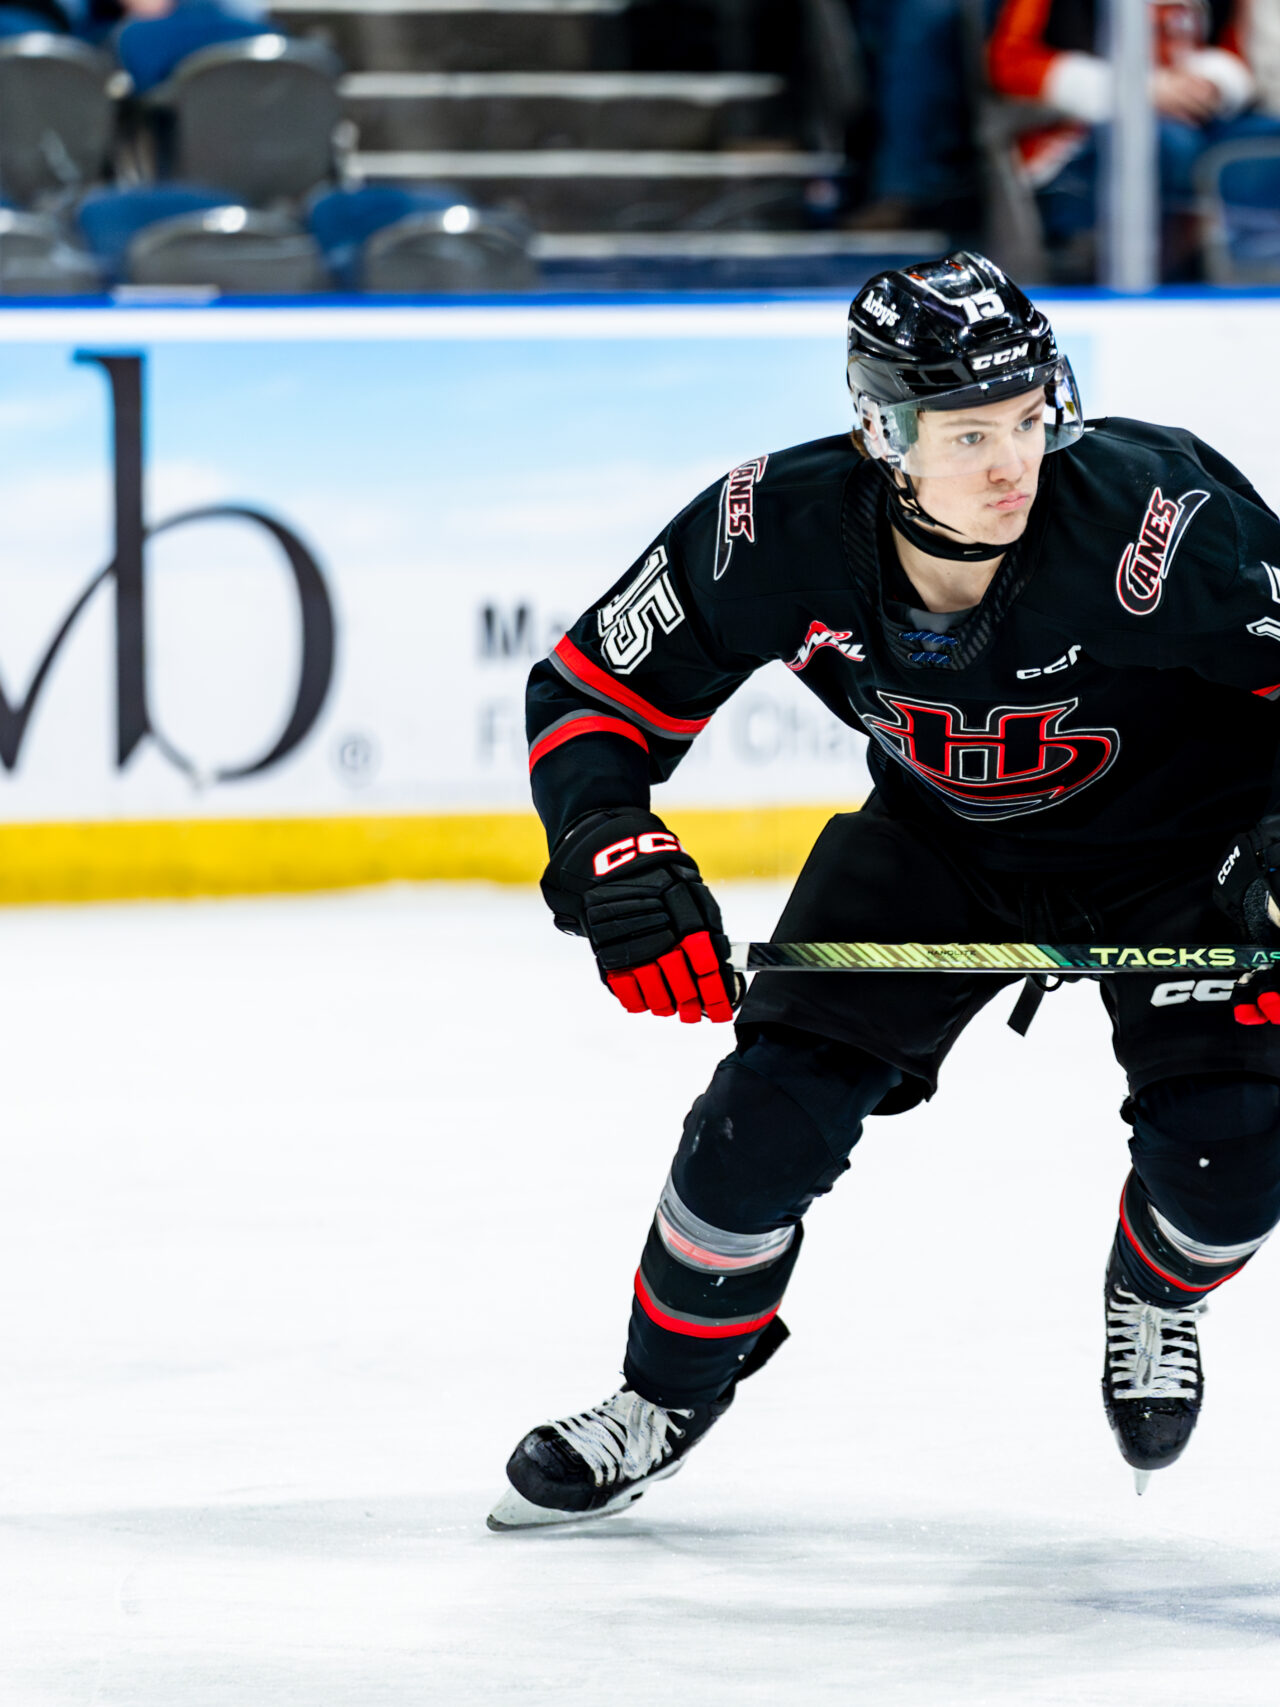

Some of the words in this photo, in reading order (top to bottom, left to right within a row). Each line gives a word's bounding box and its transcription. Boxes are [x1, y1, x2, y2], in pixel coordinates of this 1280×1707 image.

[971, 342, 1029, 371] CCM
[1116, 487, 1180, 615] CANES
[597, 545, 686, 675] 15
[592, 831, 686, 876] CC
[1217, 845, 1240, 885] CCM
[1090, 947, 1236, 966] TACKS
[1150, 979, 1237, 1008] CC
